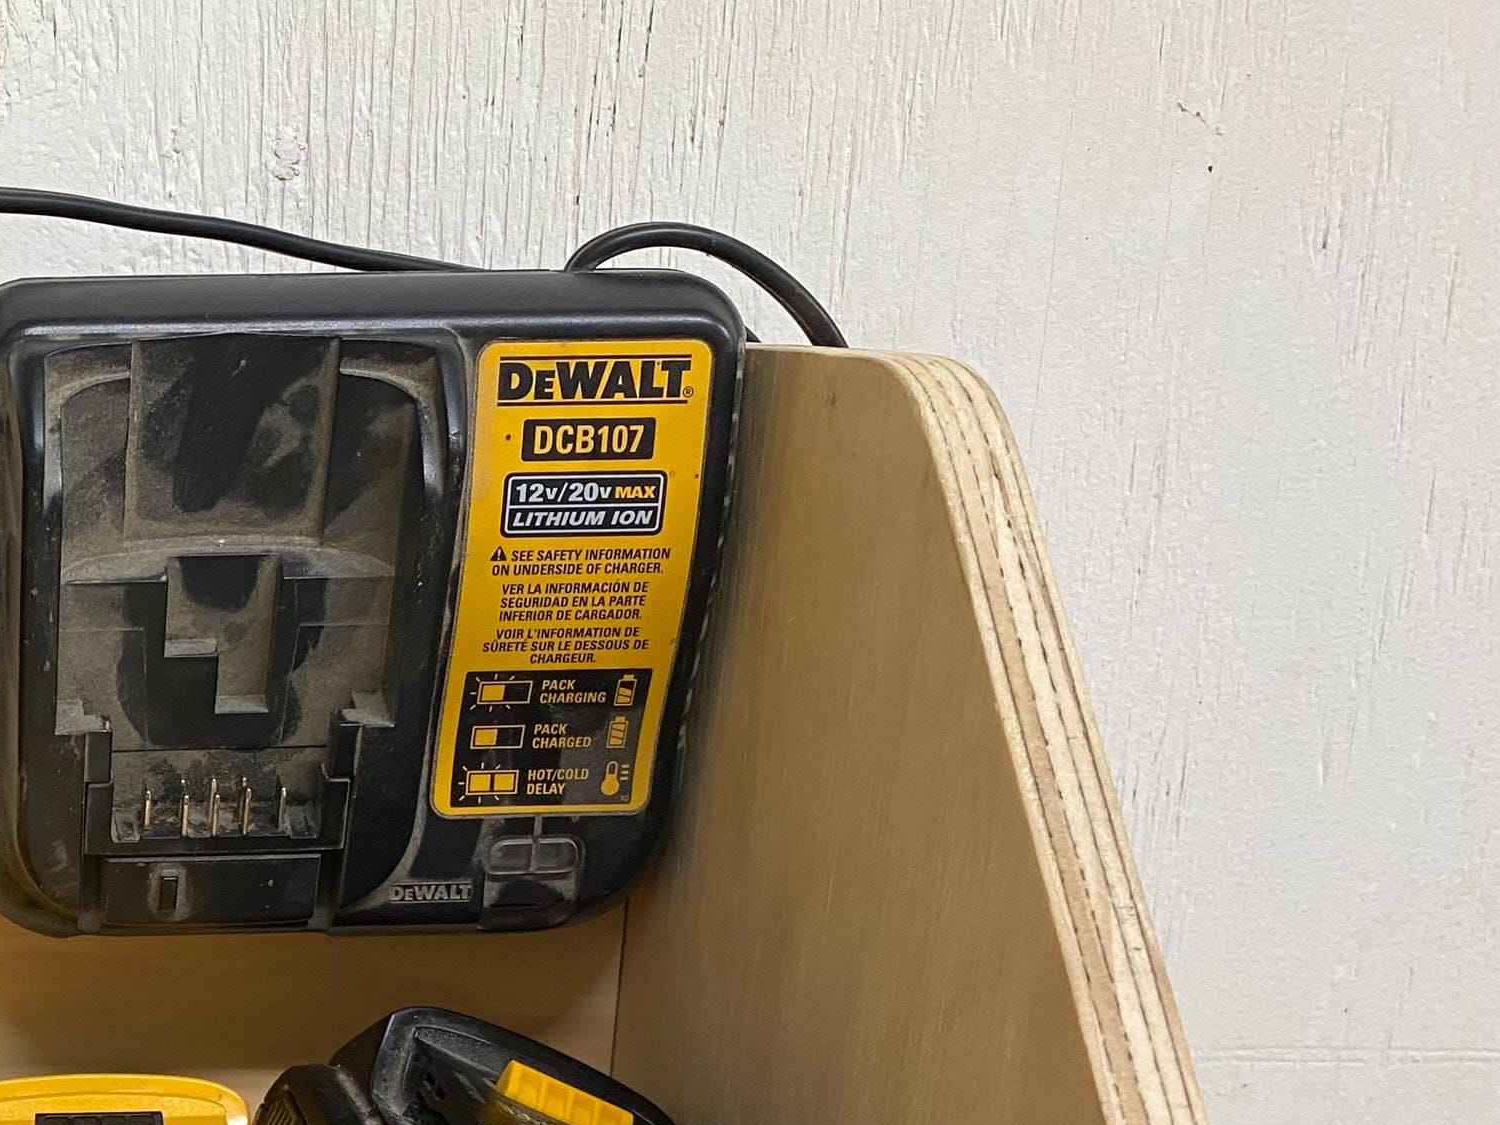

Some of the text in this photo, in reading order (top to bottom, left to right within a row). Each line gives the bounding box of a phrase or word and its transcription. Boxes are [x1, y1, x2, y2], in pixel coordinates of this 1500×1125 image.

[534, 425, 644, 454] DCB107
[615, 486, 656, 499] MAX
[513, 510, 652, 526] LITHIUM ION
[511, 548, 671, 561] SEE SAFETY INFORMATION
[492, 563, 663, 576] ON UNDERSIDE OF CHARGER.
[502, 579, 648, 594] VER LA INFORMACIÓN DE
[501, 595, 646, 608] SEGURIDAD EN LA PARTE
[500, 609, 642, 621] INFERIOR DE CARGADOR.
[496, 627, 640, 639] VOIR L'INFORMATION DE
[483, 638, 648, 652] SÛRETÉ SUR LE DESSOUS DE
[530, 653, 596, 664] CHARGEUR.
[542, 680, 576, 690] PACK
[540, 692, 606, 703] CHARGING
[534, 724, 567, 735] PACK
[532, 737, 591, 748] CHARGED
[528, 769, 589, 781] HOT/COLD
[527, 783, 566, 795] DELAY
